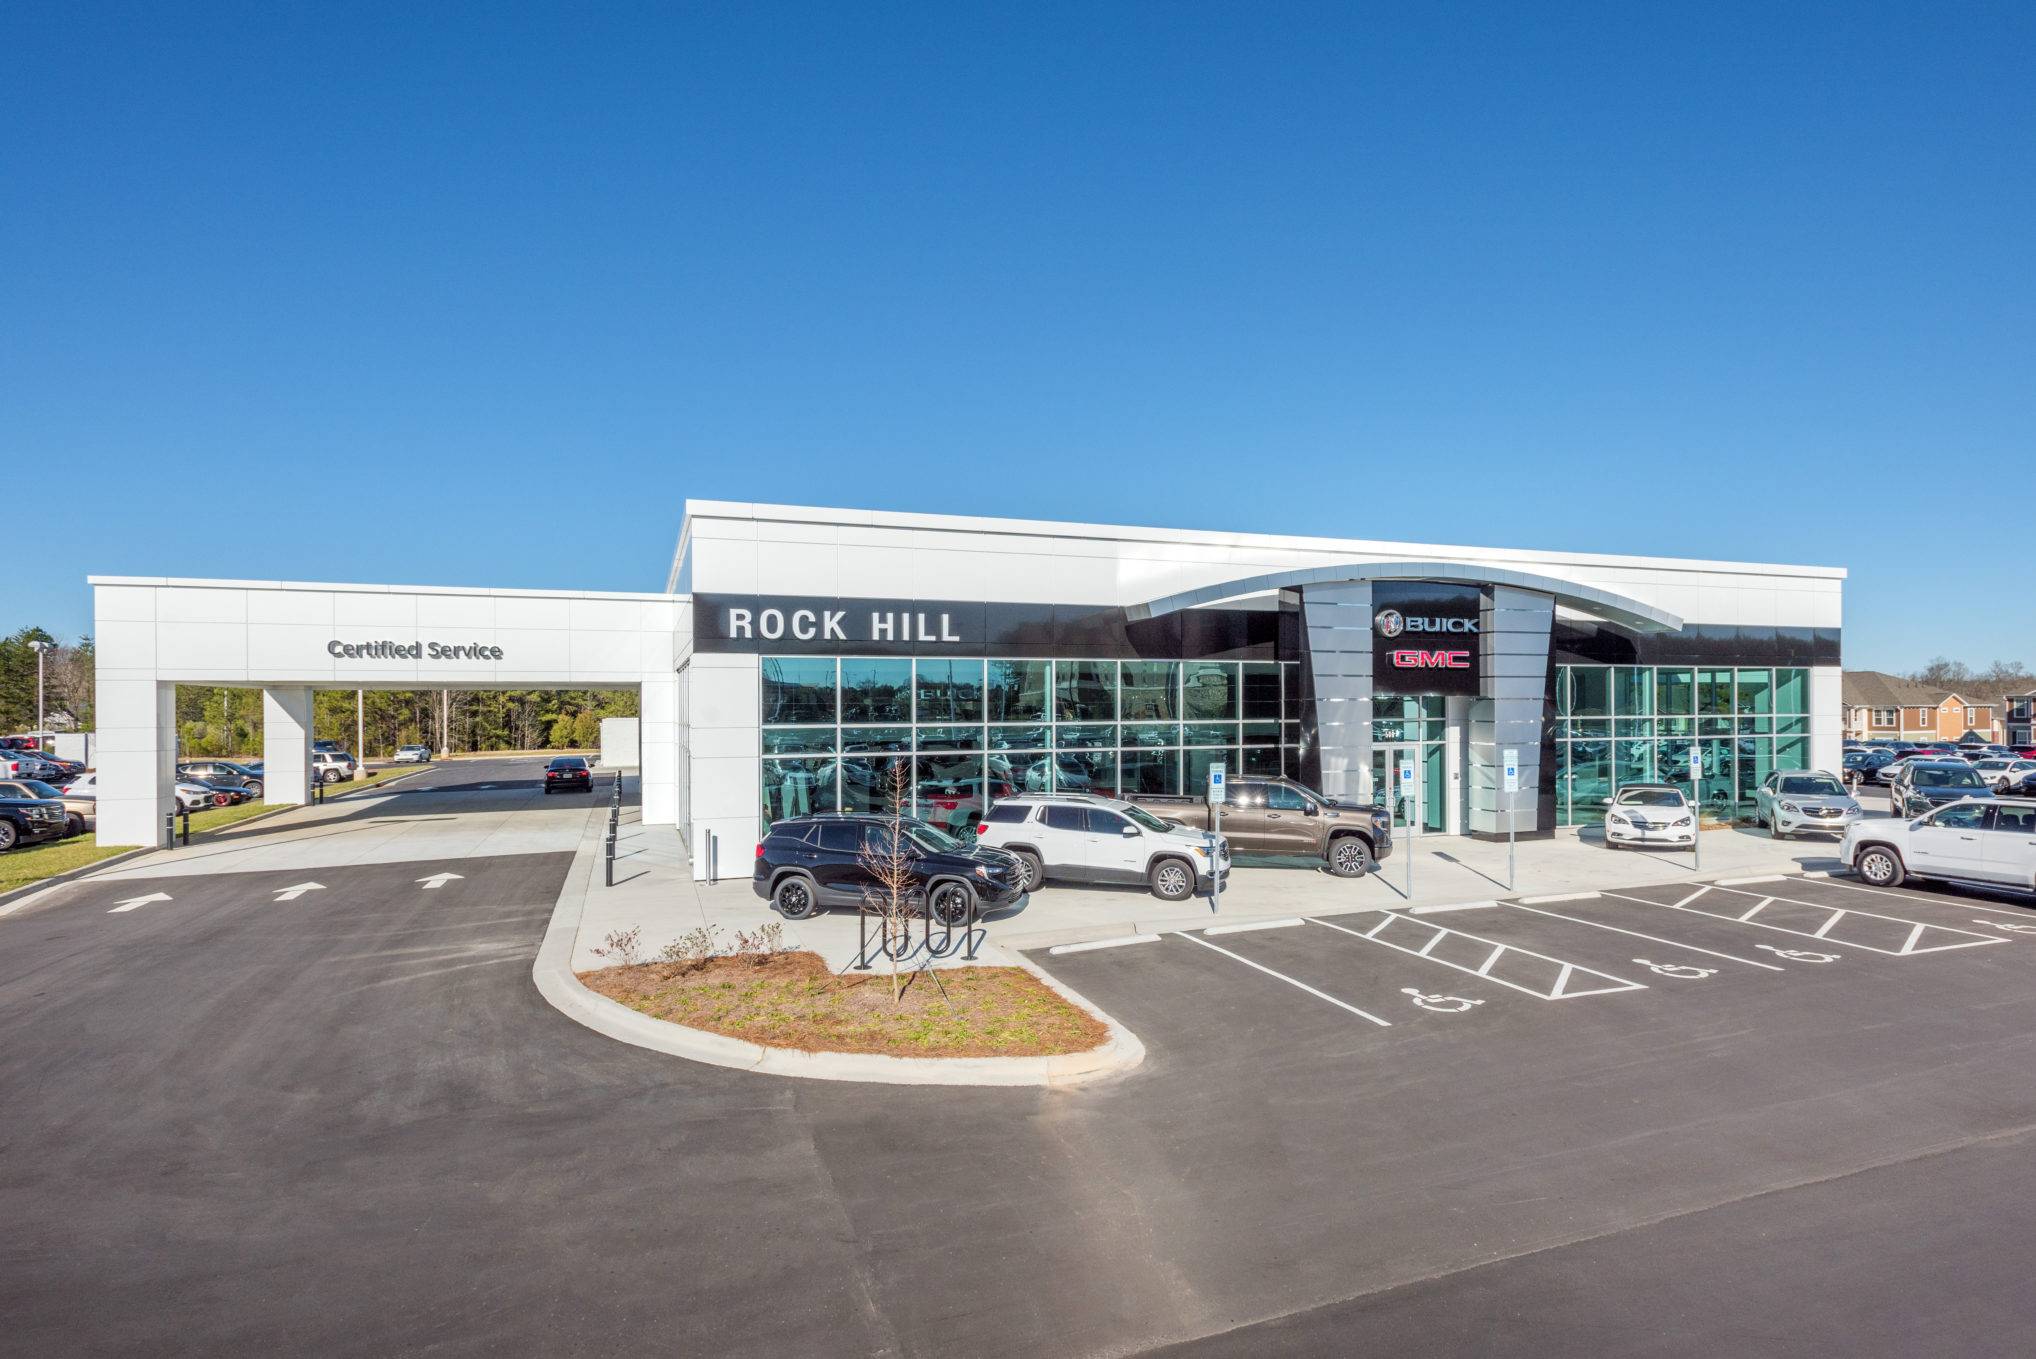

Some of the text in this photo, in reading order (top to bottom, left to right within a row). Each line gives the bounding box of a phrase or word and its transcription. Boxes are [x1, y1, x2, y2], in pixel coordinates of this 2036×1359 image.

[729, 608, 960, 642] ROCK HILL
[1405, 616, 1480, 633] BUICK
[327, 640, 504, 660] Certified Service
[1391, 650, 1470, 668] GMC
